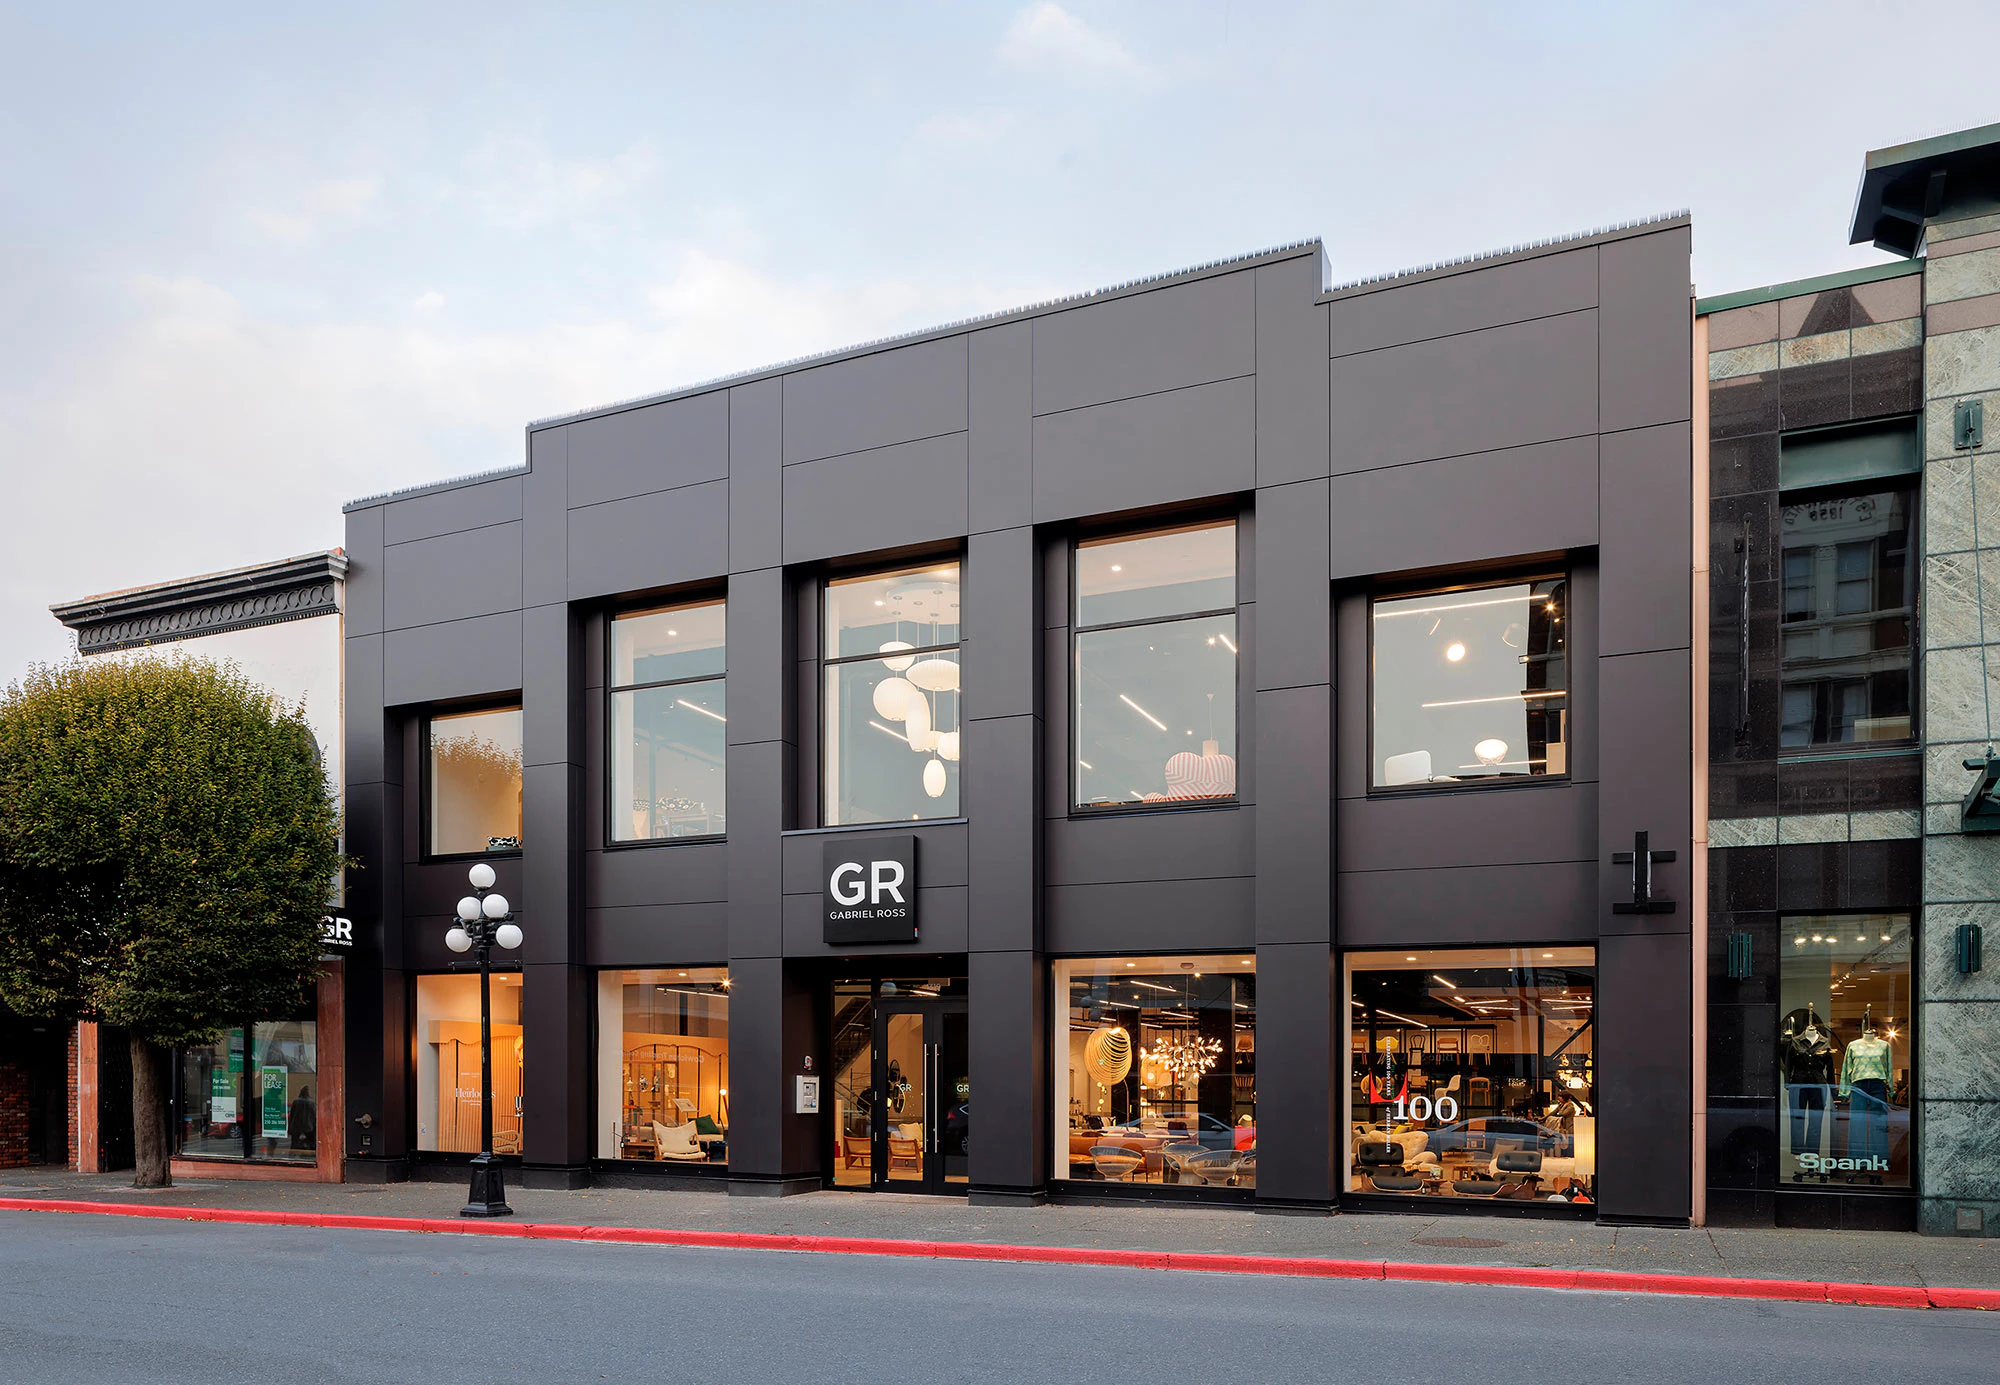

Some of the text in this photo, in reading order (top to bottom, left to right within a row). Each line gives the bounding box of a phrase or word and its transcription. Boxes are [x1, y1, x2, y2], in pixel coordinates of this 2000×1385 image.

[830, 861, 905, 906] GR
[830, 908, 906, 920] GABRIEL ROSS
[264, 1081, 282, 1089] LEASE
[900, 1083, 912, 1092] GR
[956, 1084, 969, 1093] GR
[455, 1087, 497, 1098] Heirlos
[1393, 1095, 1458, 1121] 100
[1800, 1152, 1889, 1173] Spank
